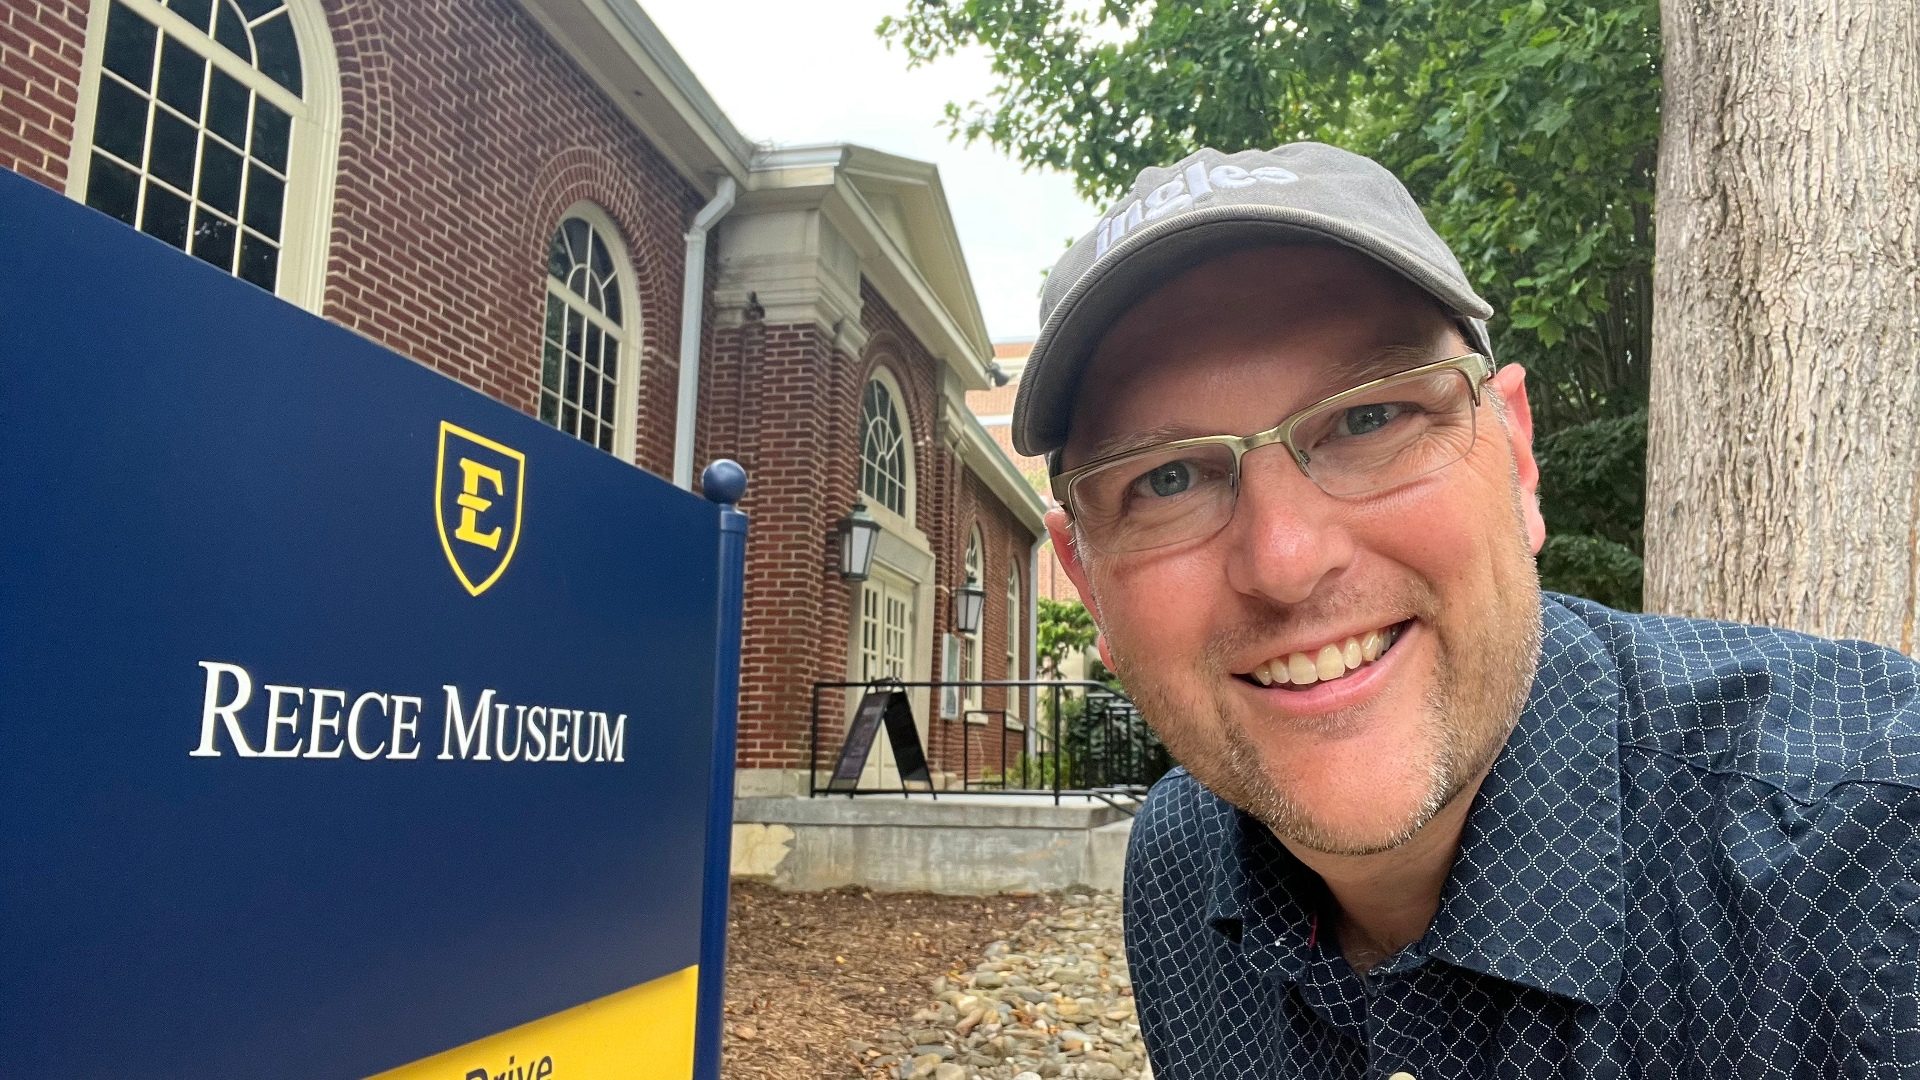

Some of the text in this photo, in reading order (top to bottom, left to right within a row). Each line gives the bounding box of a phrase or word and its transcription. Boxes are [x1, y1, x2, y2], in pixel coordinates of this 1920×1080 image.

[455, 457, 503, 551] E
[189, 661, 627, 762] REECE MUSEUM
[466, 1055, 552, 1080] ive
